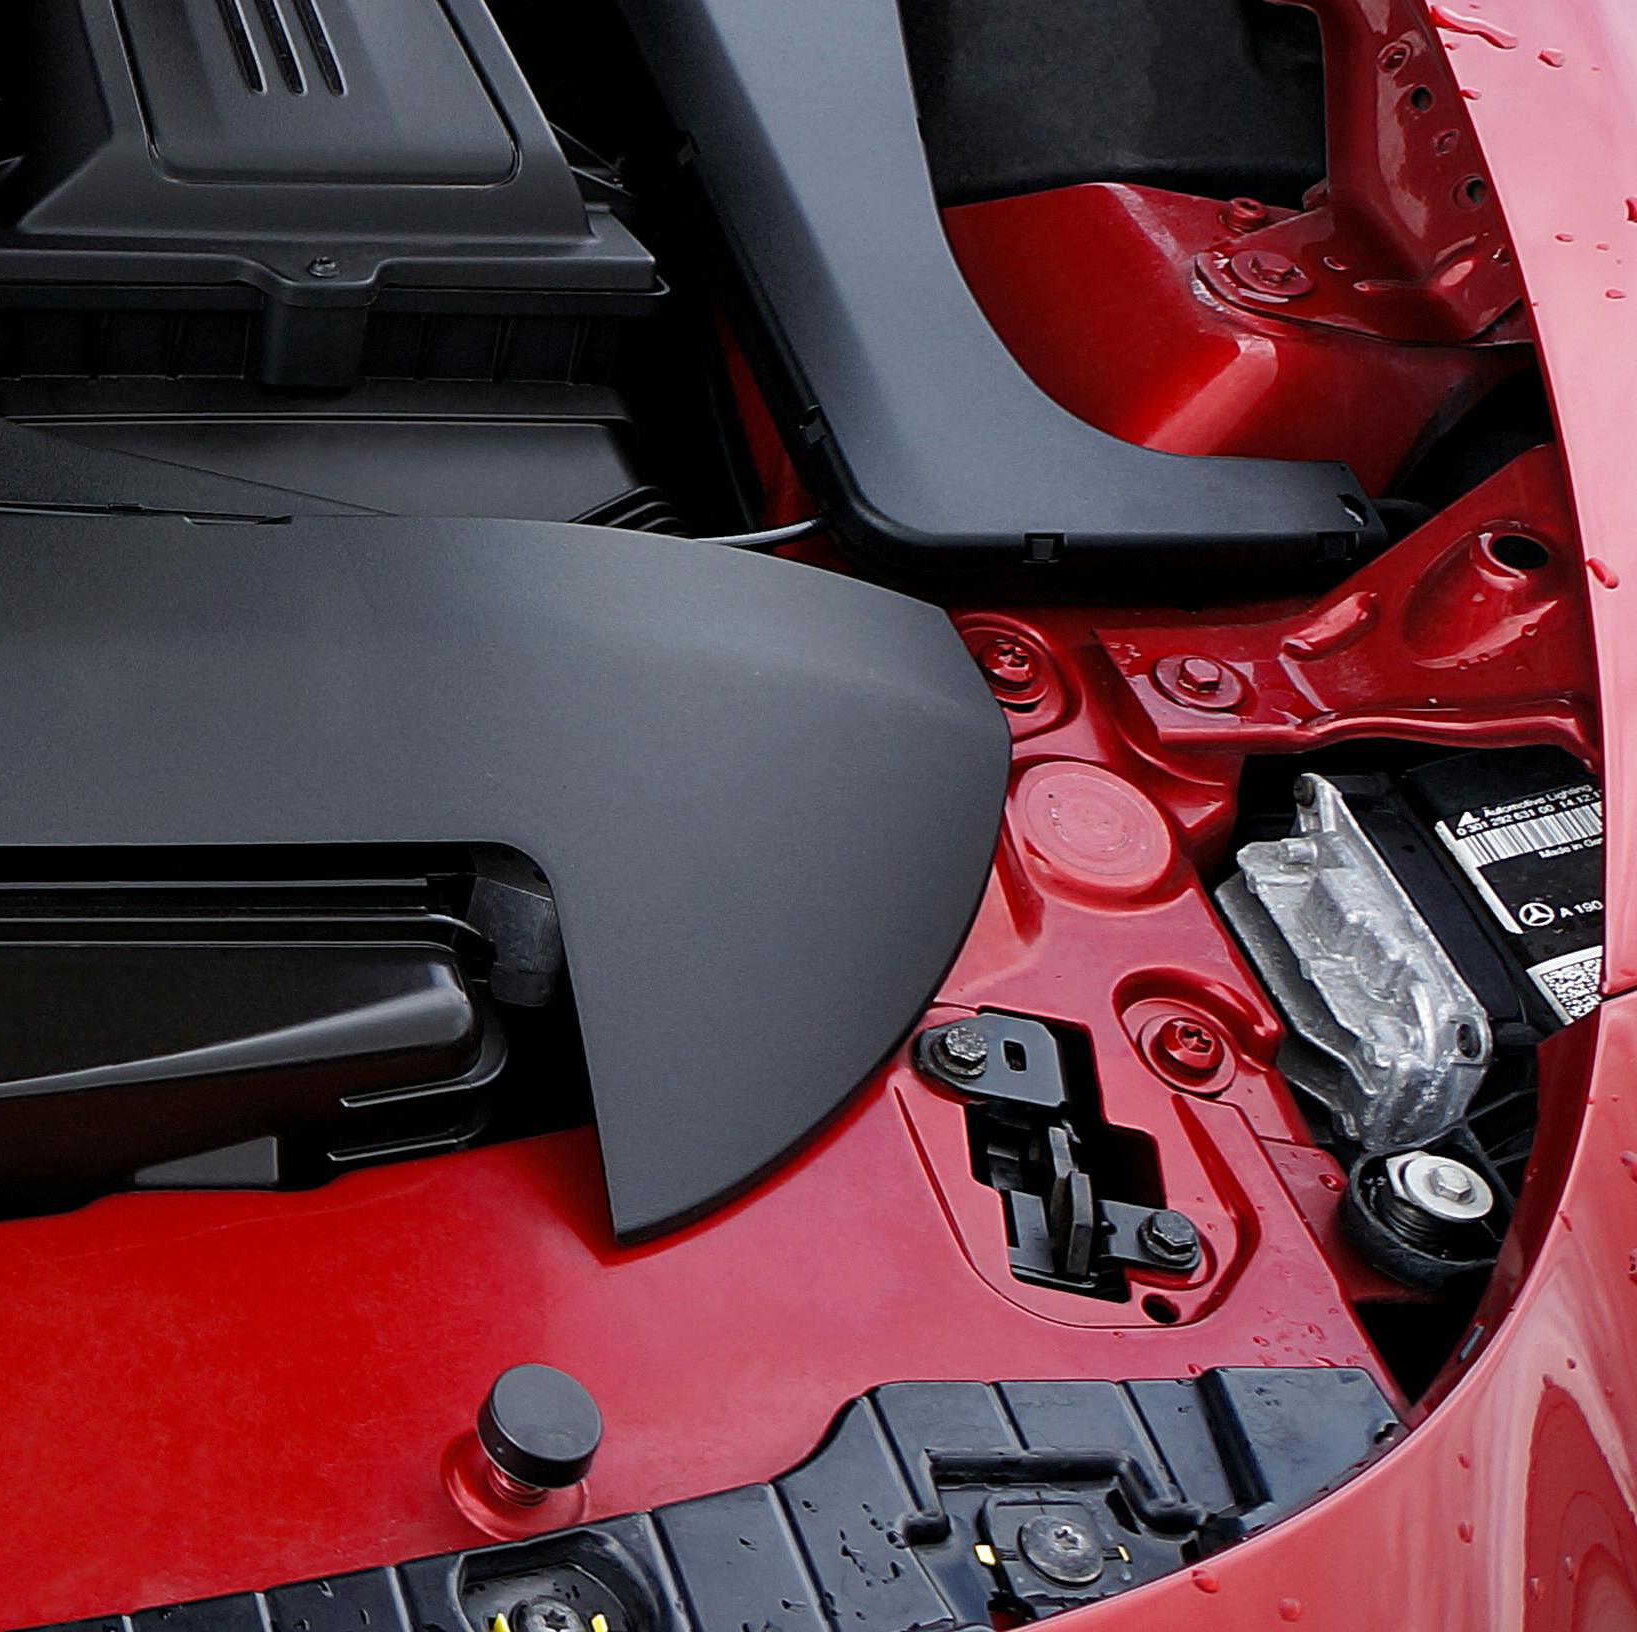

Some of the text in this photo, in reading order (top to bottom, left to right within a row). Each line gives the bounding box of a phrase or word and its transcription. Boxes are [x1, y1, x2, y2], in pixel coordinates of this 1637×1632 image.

[1483, 783, 1593, 818] Automotive Lighting
[1537, 803, 1556, 815] 00
[1558, 788, 1602, 809] 14.12.1
[1538, 846, 1572, 859] Made
[1570, 842, 1584, 851] in
[1559, 906, 1574, 919] A
